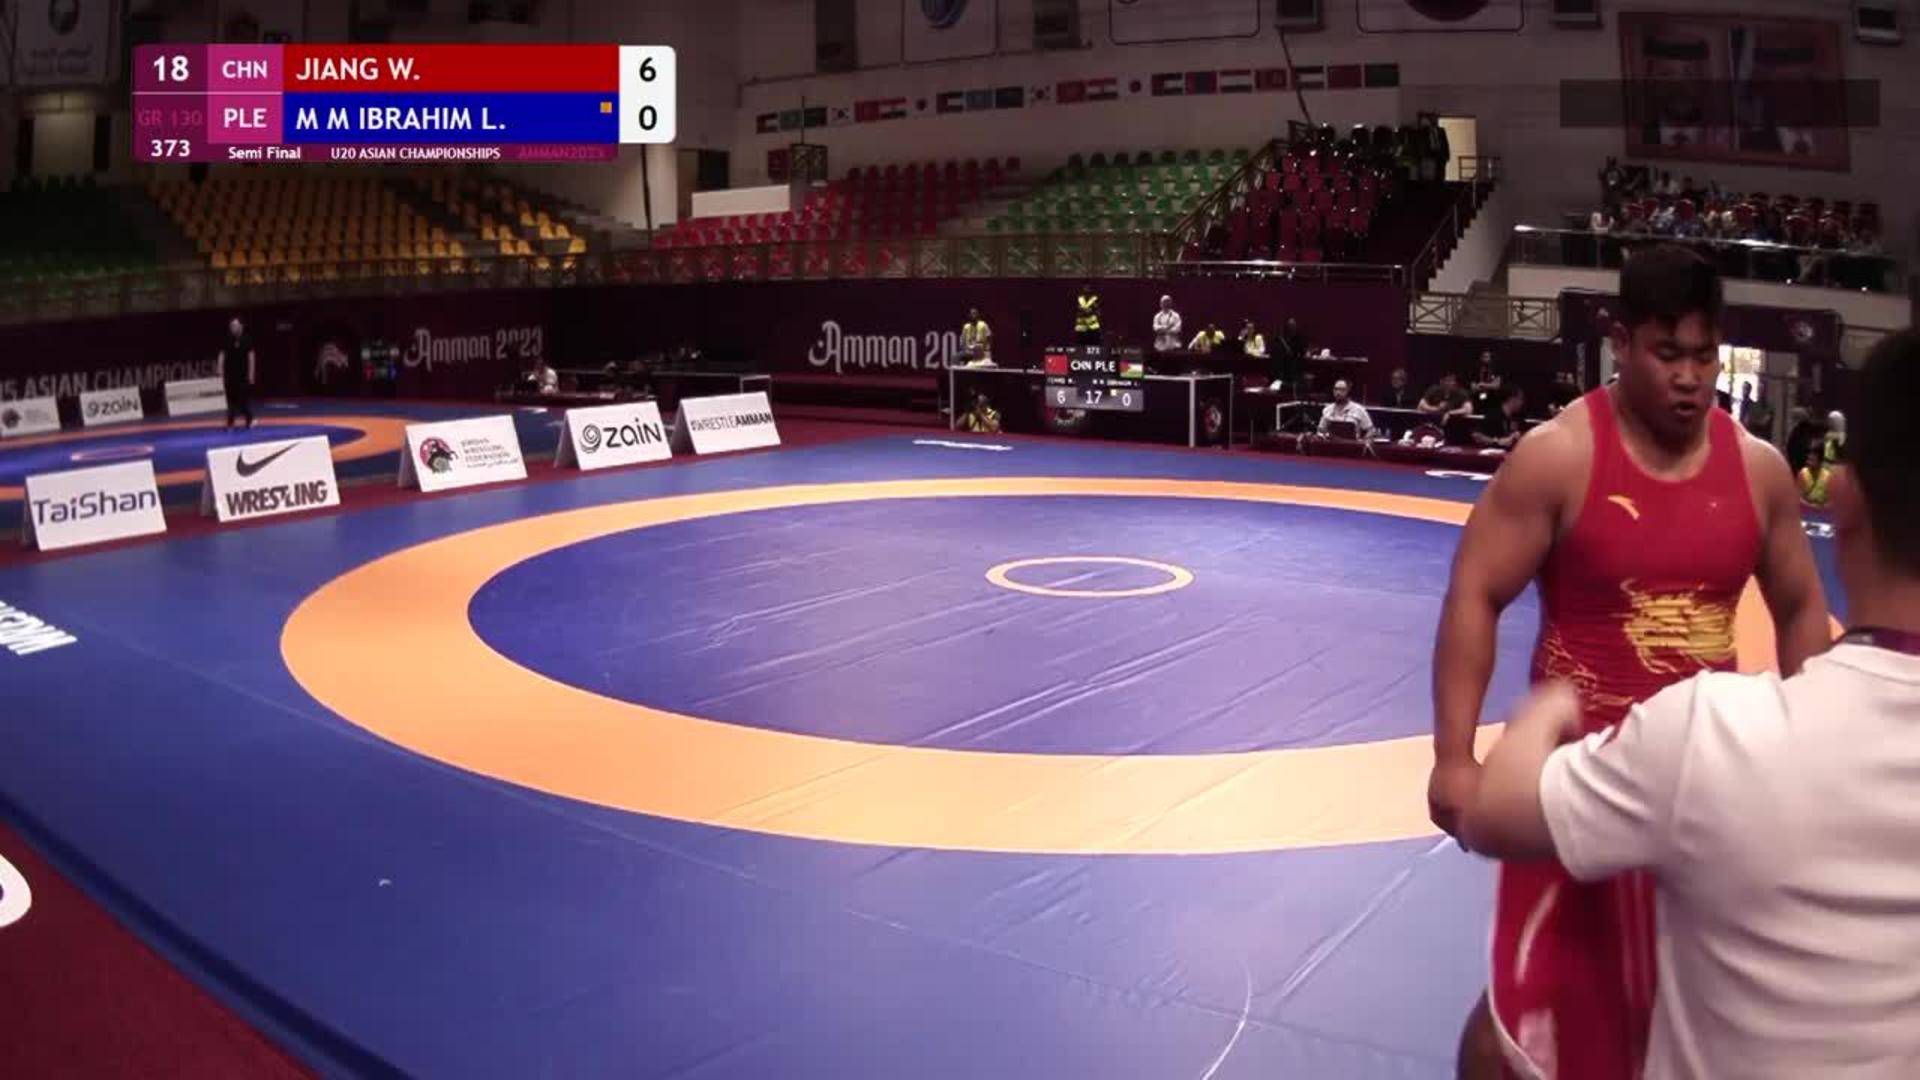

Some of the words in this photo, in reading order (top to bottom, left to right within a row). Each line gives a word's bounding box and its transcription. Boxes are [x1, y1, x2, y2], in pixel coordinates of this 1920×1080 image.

[403, 327, 492, 372] Amman
[808, 320, 918, 373] Amman
[1095, 360, 1116, 373] PLE
[1057, 390, 1066, 404] 6
[1085, 390, 1103, 405] 17
[1122, 392, 1132, 407] 0
[33, 489, 157, 525] TaiShan
[225, 480, 328, 517] WRESTLING
